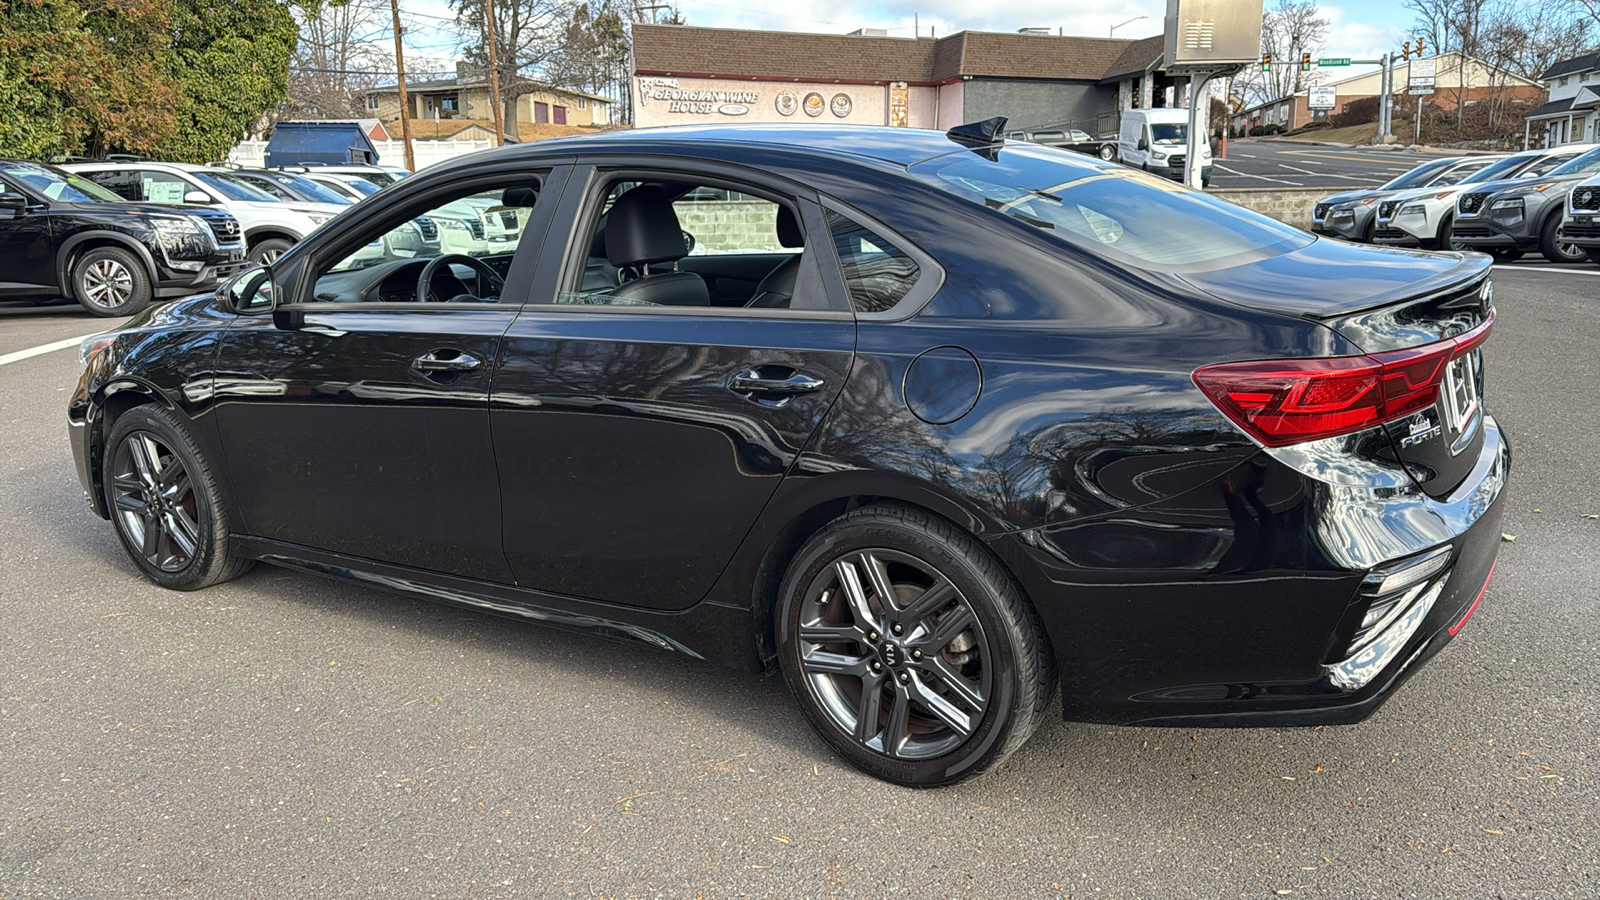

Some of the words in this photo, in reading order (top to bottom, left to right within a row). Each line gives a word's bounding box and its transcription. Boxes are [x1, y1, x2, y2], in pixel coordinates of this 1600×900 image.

[654, 89, 720, 101] GEORGIAN
[723, 91, 759, 103] WINE
[669, 101, 713, 114] HOUSE
[1400, 425, 1441, 449] FORTE
[865, 527, 935, 551] GENERAL
[885, 644, 896, 666] KIA
